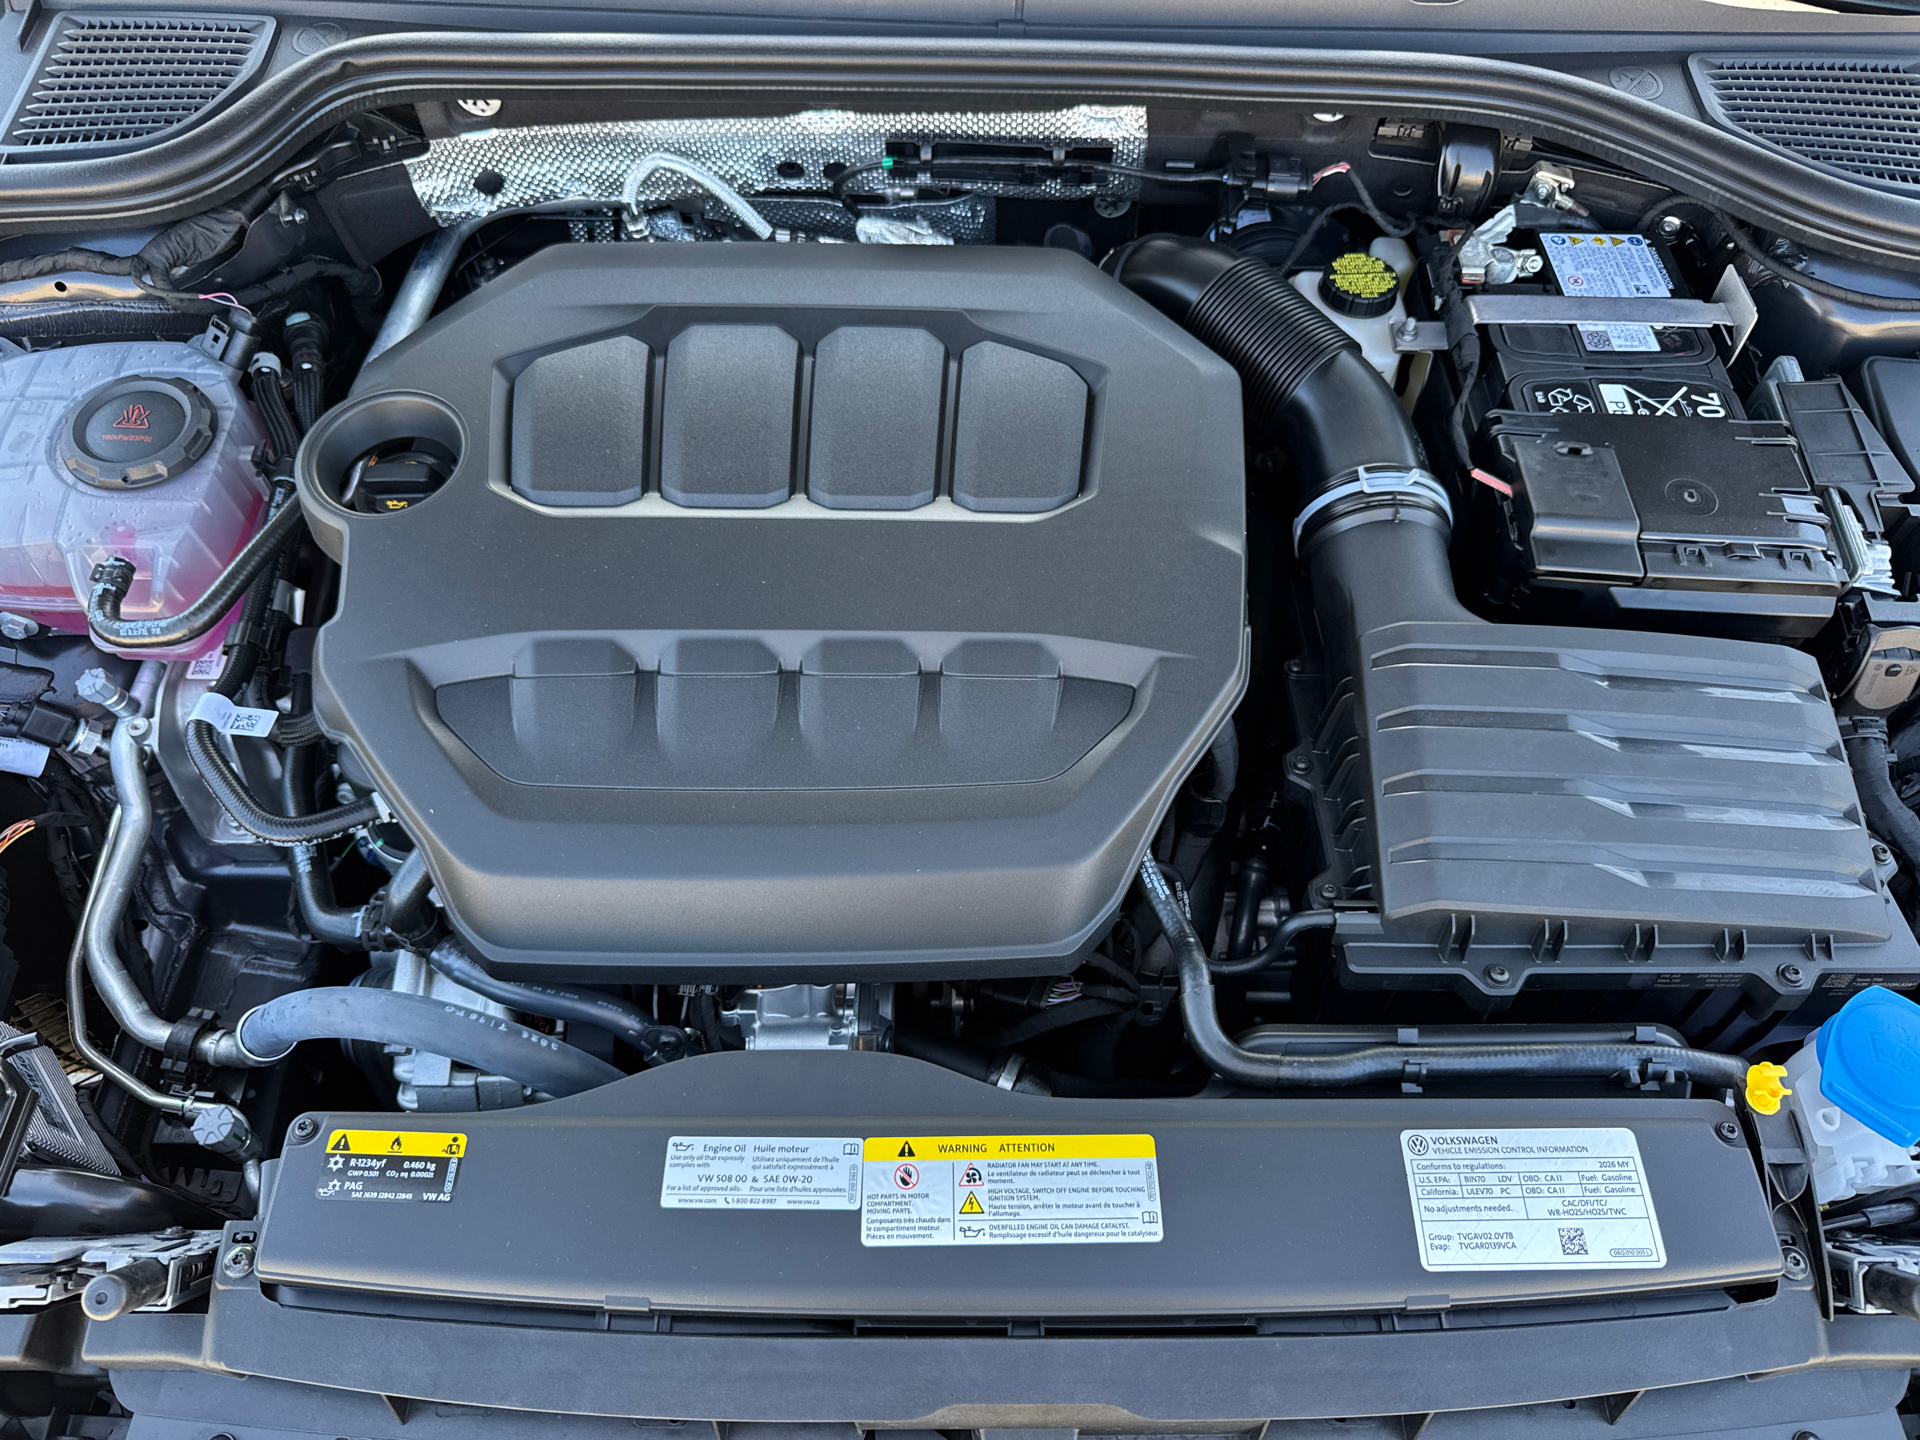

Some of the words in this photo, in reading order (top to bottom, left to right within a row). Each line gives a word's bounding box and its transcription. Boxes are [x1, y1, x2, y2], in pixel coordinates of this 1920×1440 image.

[1649, 248, 1674, 290] DANGER/POISON
[1691, 392, 1726, 418] 70
[16, 1054, 29, 1071] AG
[24, 1070, 39, 1088] VW
[1429, 1136, 1498, 1145] VOLKSWAGEN
[703, 1143, 732, 1154] Engine
[733, 1144, 746, 1152] Oil
[753, 1144, 776, 1153] Huile
[777, 1145, 809, 1153] moteur
[937, 1143, 987, 1153] WARNING
[998, 1142, 1054, 1152] ATTENTION
[1500, 1145, 1536, 1153] CONTROL
[1536, 1145, 1588, 1153] INFORMATION
[682, 1154, 695, 1162] only
[717, 1154, 745, 1163] expressly
[349, 1158, 387, 1169] R-1234yf
[403, 1160, 425, 1169] 0.460
[426, 1161, 436, 1171] kg
[669, 1161, 695, 1169] complies
[786, 1163, 828, 1171] expressément
[1416, 1162, 1452, 1170] Conforms
[1462, 1162, 1506, 1172] regulations:
[697, 1174, 714, 1182] VW
[716, 1174, 732, 1182] 508
[734, 1174, 747, 1182] 00
[763, 1174, 780, 1183] SAE
[782, 1174, 812, 1183] 0W-20
[1581, 1173, 1598, 1182] Fuel:
[343, 1181, 363, 1190] PAG
[699, 1184, 728, 1192] approved
[812, 1186, 847, 1194] approuvées:
[1584, 1185, 1601, 1195] Fuel:
[987, 1188, 1003, 1196] HIGH
[1003, 1187, 1031, 1196] VOLTAGE,
[1420, 1187, 1459, 1196] California:
[422, 1192, 437, 1200] VW
[437, 1192, 450, 1201] AG
[988, 1203, 1006, 1212] Haute
[1436, 1204, 1482, 1214] adjustments
[1483, 1203, 1513, 1211] needed.
[866, 1217, 902, 1225] Composants
[988, 1231, 1026, 1239] Remplissage
